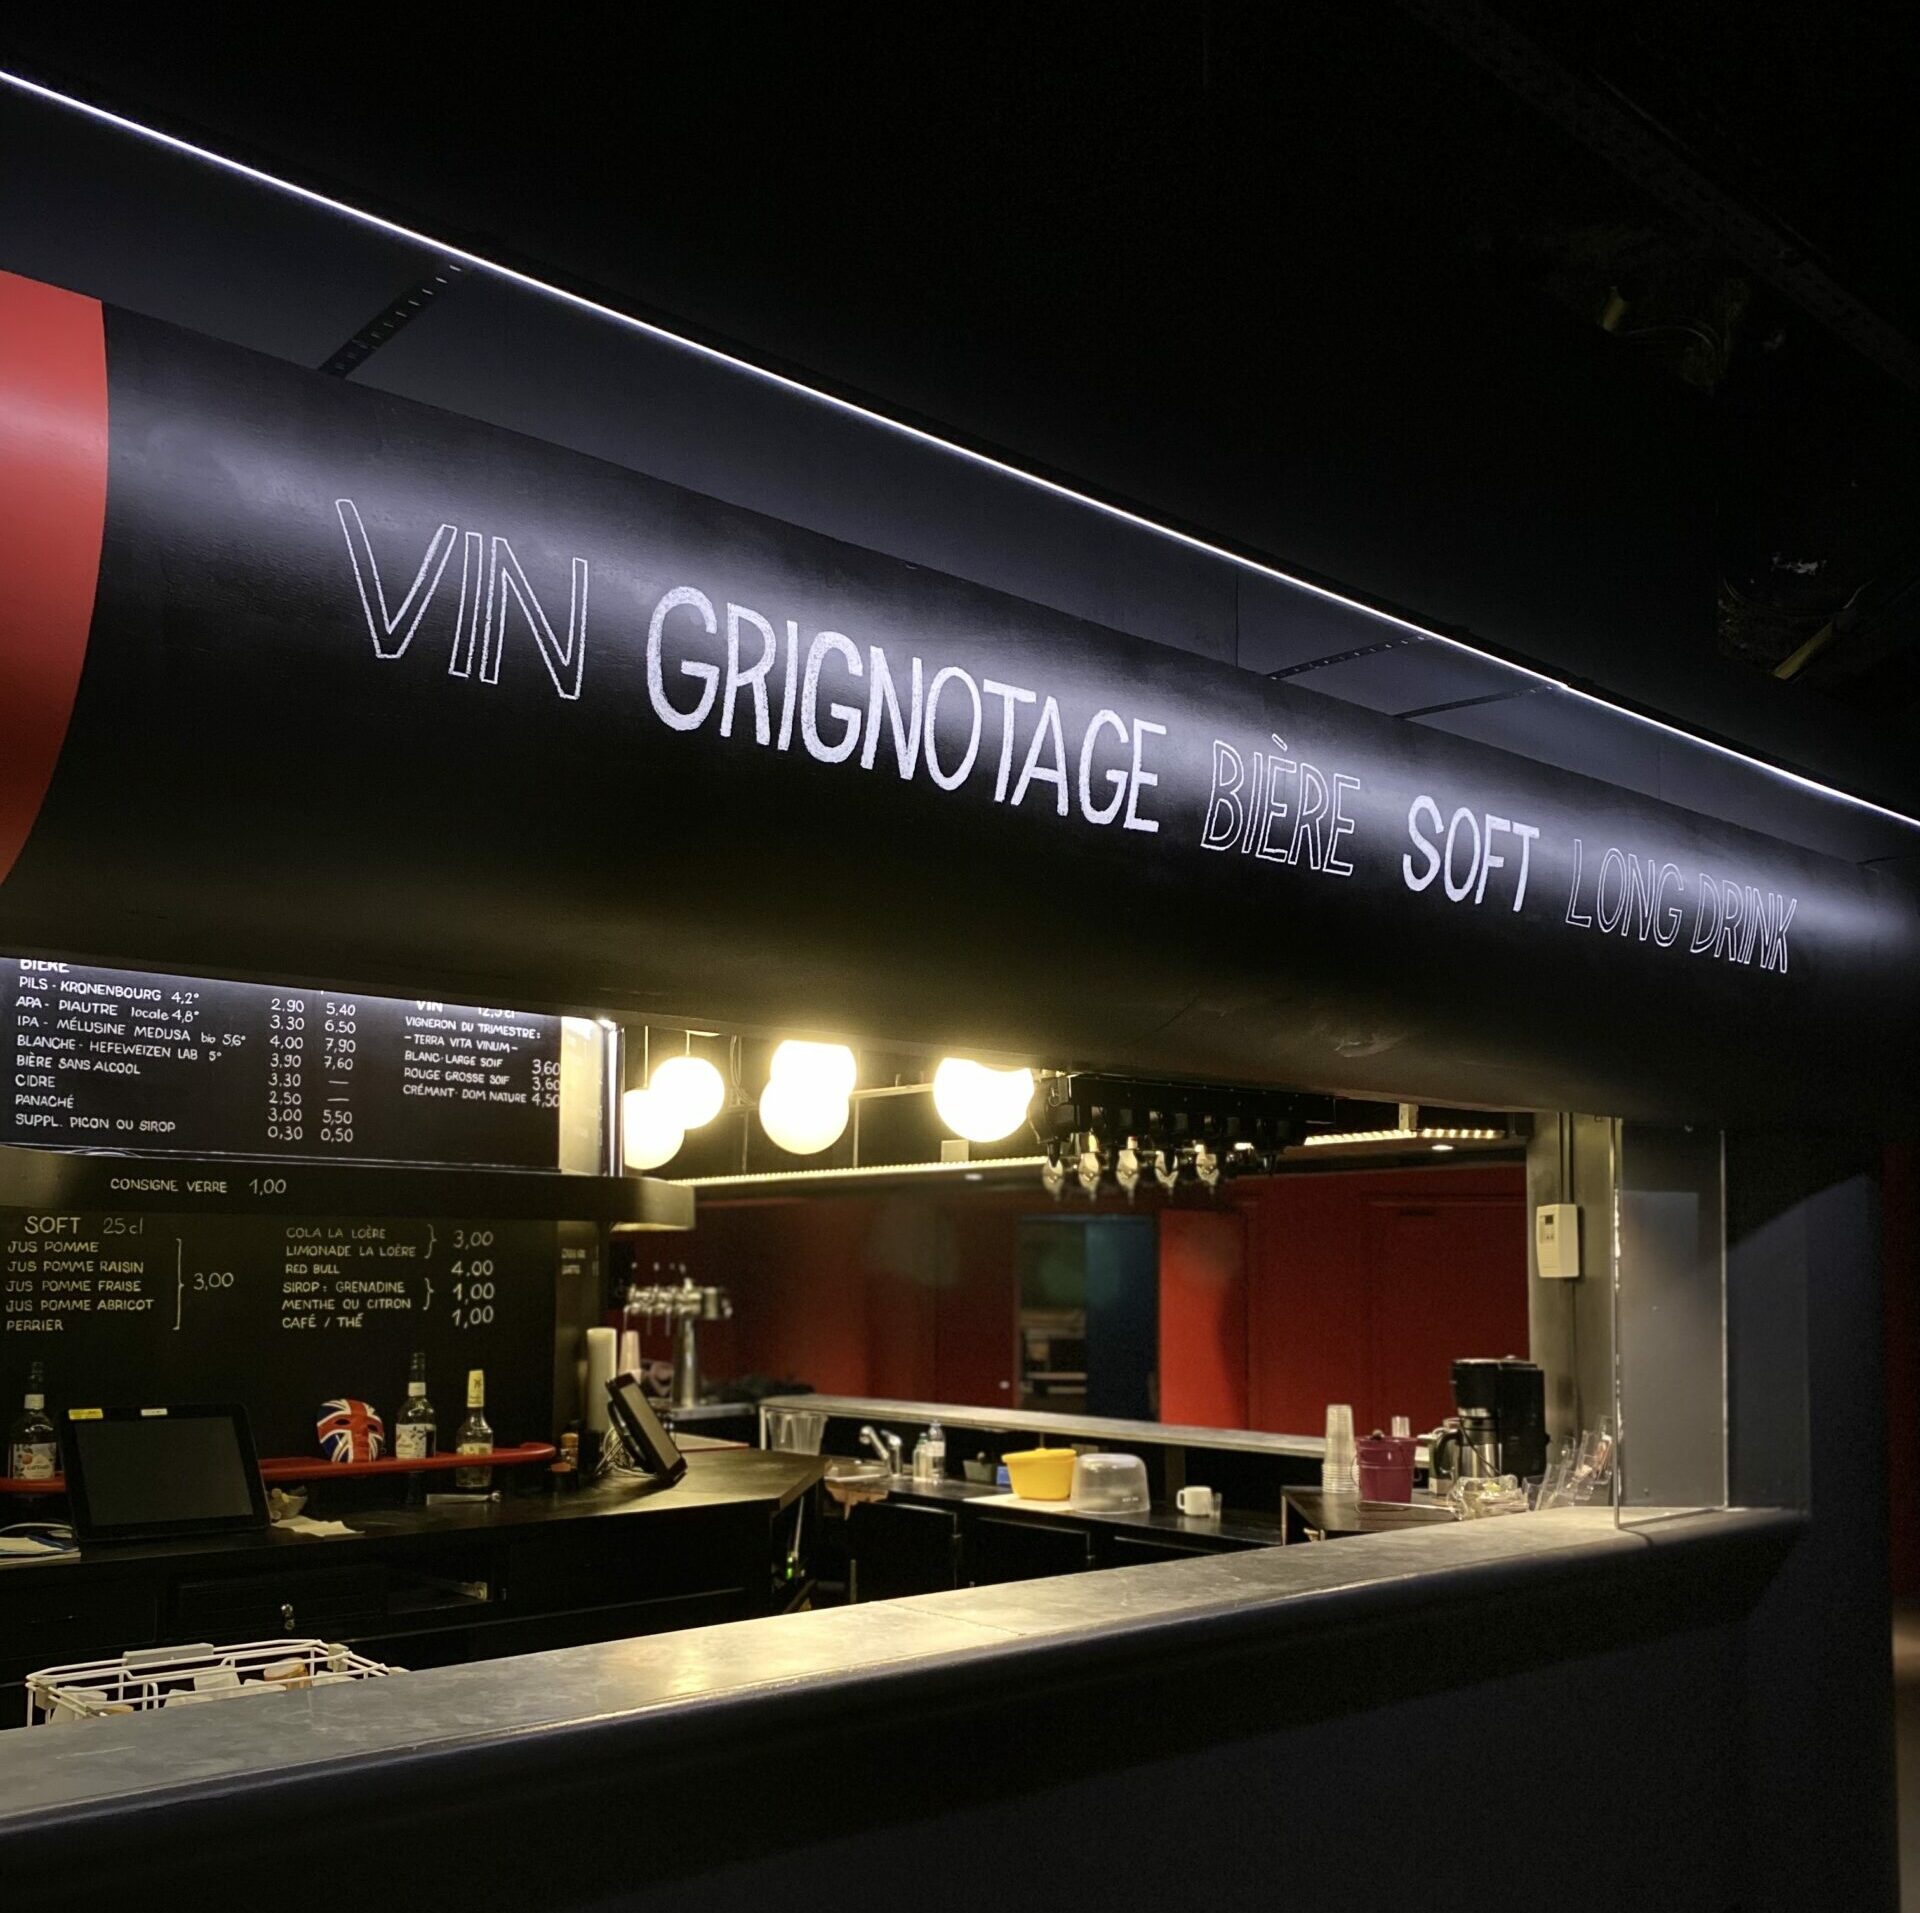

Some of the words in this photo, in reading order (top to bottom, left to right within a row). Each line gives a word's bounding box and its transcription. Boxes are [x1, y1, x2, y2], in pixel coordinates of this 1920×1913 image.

[335, 497, 589, 701] VIN
[644, 585, 1167, 834] GRIGNOTAGE
[1201, 733, 1361, 877] BIÈRE
[1402, 795, 1540, 912] SOFT
[1565, 838, 1685, 949] LONG
[1690, 871, 1798, 974] DRINK
[19, 976, 48, 990] PILS
[60, 980, 162, 1001] KRONENBOURG
[16, 996, 42, 1009] APA
[58, 1000, 119, 1017] PIAUTRE
[131, 1007, 169, 1021] locale
[17, 1015, 39, 1028] IPA
[56, 1017, 126, 1036] MÉLUSINE
[134, 1026, 191, 1042] MEDUSA
[201, 1031, 216, 1044] bio
[405, 1016, 457, 1031] VIGNERON
[461, 1021, 474, 1032] DU
[17, 1034, 76, 1051] BLANCHE
[89, 1040, 171, 1059] HEFEWEIZEN
[414, 1034, 445, 1046] TERRA
[450, 1037, 473, 1049] VITA
[476, 1040, 510, 1053] VINUM
[16, 1051, 53, 1068] BIÈRE
[58, 1057, 91, 1071] SANS
[445, 1055, 476, 1067] LARGE
[480, 1058, 504, 1068] SOIF
[15, 1073, 56, 1089] CIDRE
[404, 1067, 440, 1081] ROUGE
[445, 1071, 485, 1084] GROSSE
[489, 1074, 510, 1085] SOIF
[15, 1093, 74, 1109] PANACHÉ
[462, 1089, 486, 1101] DOM
[489, 1091, 527, 1103] NATURE
[15, 1113, 63, 1128] SUPPL.
[70, 1116, 110, 1130] PICON
[116, 1118, 134, 1131] OU
[139, 1120, 176, 1133] SIROP
[110, 1178, 179, 1192] CONSIGNE
[186, 1180, 228, 1194] VERRE
[248, 1178, 287, 1196] 1,00
[24, 1216, 81, 1235] SOFT
[286, 1227, 321, 1239] COLA
[328, 1227, 344, 1239] LA
[7, 1241, 38, 1253] JUS
[44, 1241, 99, 1253] POMME
[286, 1245, 351, 1257] LIMONADE
[359, 1245, 374, 1257] LA
[7, 1261, 37, 1273] JUS
[43, 1260, 94, 1273] POMME
[100, 1261, 144, 1274] RAISIN
[285, 1264, 308, 1275] RED
[313, 1264, 340, 1275] BULL
[5, 1280, 33, 1293] JUS
[42, 1280, 91, 1292] POMME
[98, 1280, 142, 1293] FRAISE
[192, 1272, 235, 1292] 3,00
[335, 1281, 406, 1294] GRENADINE
[5, 1300, 33, 1313] JUS
[41, 1299, 91, 1312] POMME
[97, 1298, 155, 1311] ABRICOT
[281, 1298, 336, 1311] MENTHE
[342, 1298, 360, 1310] OU
[366, 1298, 412, 1310] CITRON
[6, 1318, 64, 1332] PERRIER
[282, 1314, 317, 1329] CAFÉ
[336, 1312, 365, 1328] THÉ
[451, 1305, 494, 1330] 1,00
